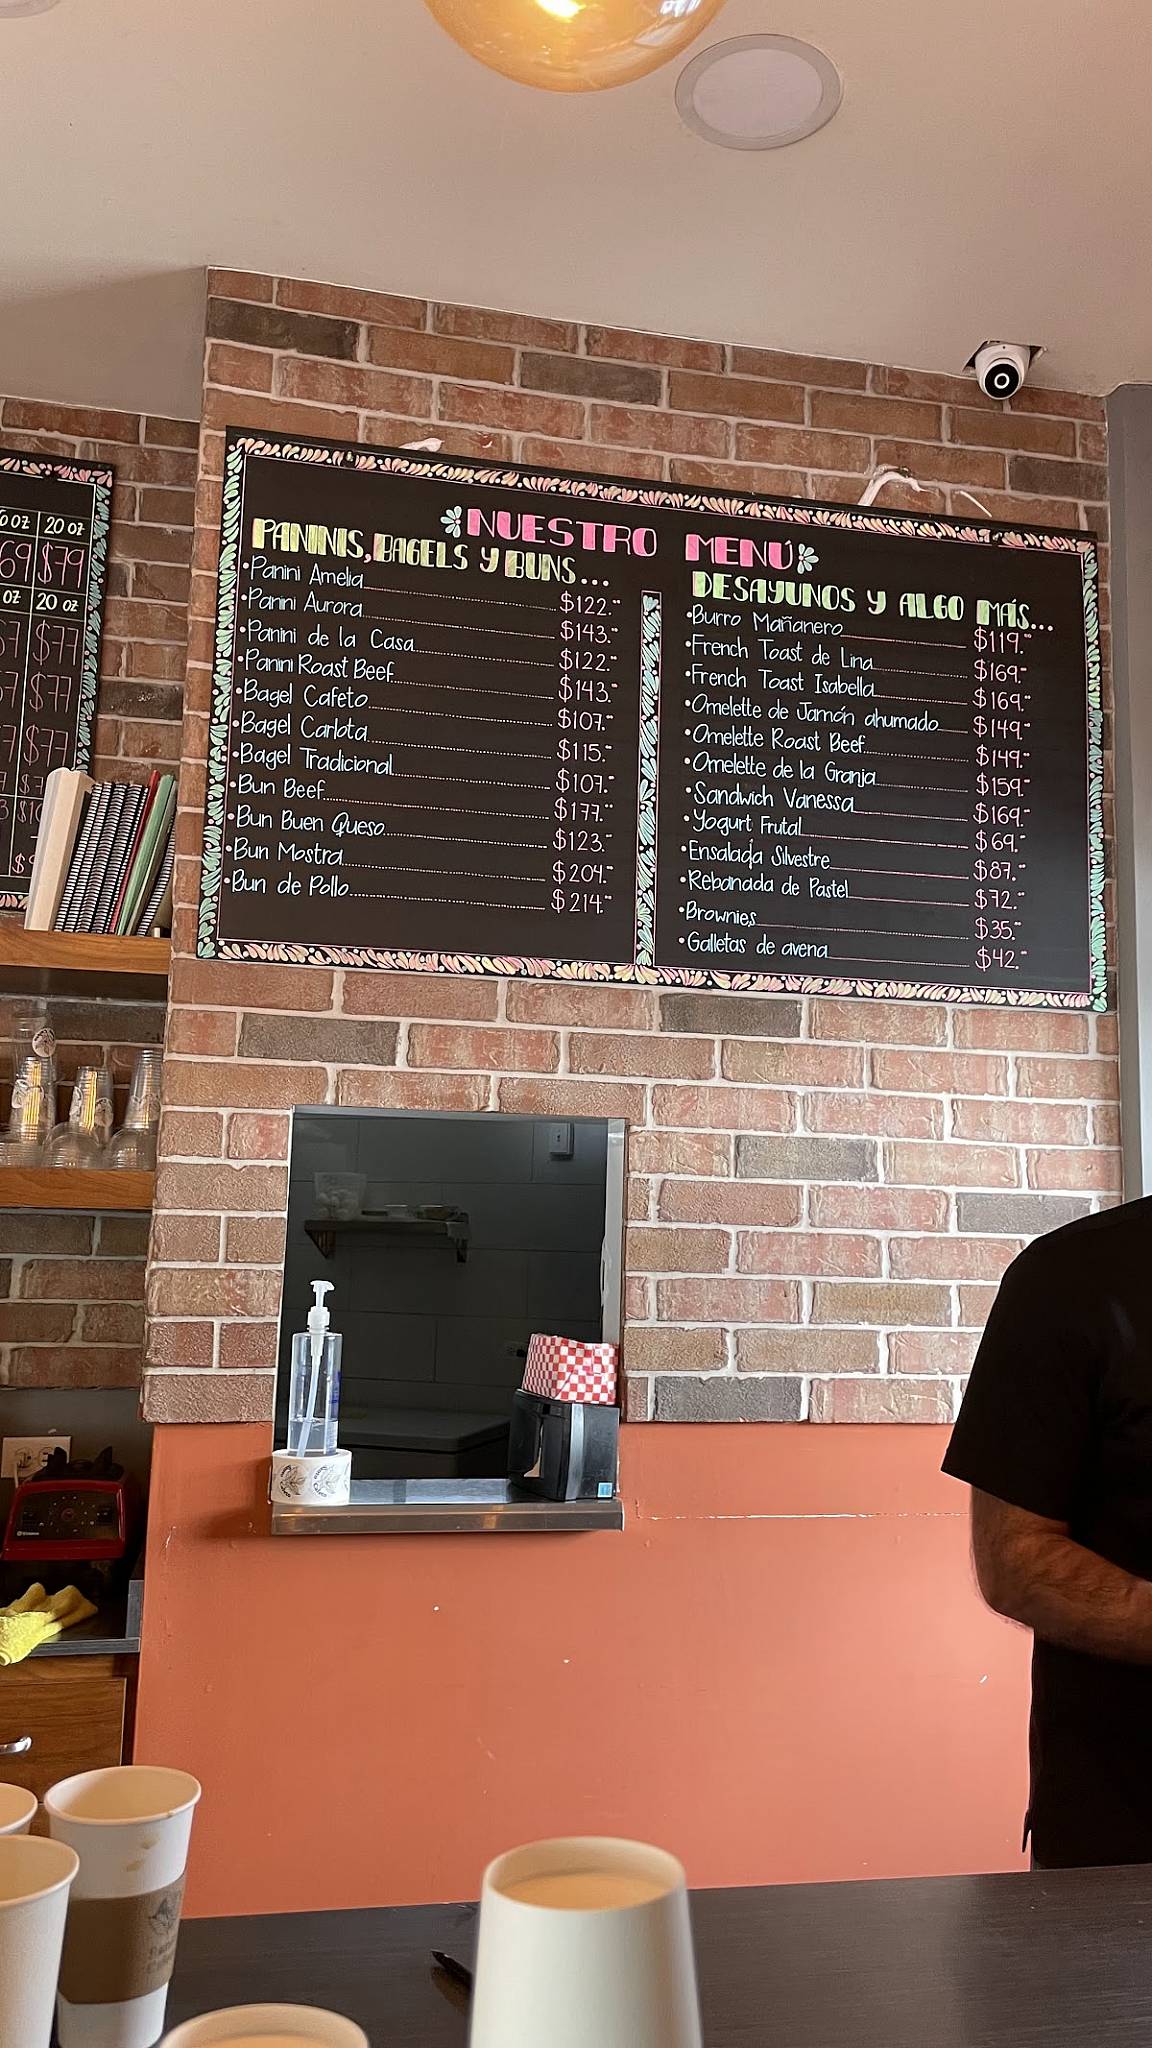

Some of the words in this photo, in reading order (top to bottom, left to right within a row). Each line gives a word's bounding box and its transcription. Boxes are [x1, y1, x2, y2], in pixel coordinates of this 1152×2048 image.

[44, 516, 65, 535] 20
[466, 508, 658, 557] NUESTRO
[685, 533, 794, 570] MENÚ
[0, 540, 32, 583] 69
[37, 541, 85, 589] $79
[374, 533, 468, 571] BAGELS
[250, 555, 301, 582] Panini
[309, 562, 364, 590] Amelia
[36, 592, 58, 611] 20
[248, 587, 297, 613] Panini
[303, 592, 363, 619] Aurora
[692, 571, 855, 612] DESAYUNOS
[899, 593, 964, 620] ALGO
[246, 618, 297, 644] Panini
[307, 626, 331, 647] de
[338, 623, 357, 648] la
[370, 629, 415, 653] Casa
[692, 604, 741, 627] Burro
[753, 611, 843, 637] Mañanero
[32, 619, 79, 666] $77
[691, 634, 749, 658] French
[757, 639, 803, 662] Toast
[811, 644, 830, 666] de
[840, 646, 874, 670] Lina
[244, 648, 294, 674] Panini
[297, 654, 349, 679] Roast
[353, 658, 394, 683] Beef
[691, 664, 747, 688] French
[757, 669, 804, 691] Toast
[814, 673, 875, 697] Isabella
[29, 671, 72, 713] $77
[243, 678, 293, 707] Bagel
[303, 684, 369, 708] Cafeto
[240, 710, 291, 738] Bagel
[300, 715, 368, 741] Carlota
[691, 694, 762, 718] Omelette
[768, 699, 789, 720] de
[796, 701, 855, 726] Jamón
[864, 708, 939, 732] ahumado
[23, 724, 69, 767] $77
[692, 723, 764, 747] Omelette
[771, 728, 821, 751] Roast
[829, 732, 866, 753] Beef
[240, 742, 291, 770] Bagel
[299, 747, 393, 776] Tradicional
[692, 751, 767, 777] Omelette
[772, 756, 794, 779] de
[799, 760, 815, 780] la
[824, 761, 876, 788] Granja
[19, 773, 44, 795] $7
[238, 773, 276, 795] Bun
[284, 778, 326, 800] Beef
[693, 781, 774, 807] Sandwich
[783, 787, 854, 812] Vanessa
[236, 804, 273, 828] Bun
[281, 810, 324, 832] Buen
[331, 812, 385, 837] Queso
[692, 808, 752, 836] Yogurt
[760, 815, 802, 836] Frutal
[233, 837, 269, 861] Bun
[278, 842, 343, 866] Mostra
[689, 839, 763, 870] Ensalada
[771, 845, 830, 869] Silvestre
[232, 869, 266, 893] Bun
[277, 872, 302, 895] de
[309, 875, 349, 897] Pollo
[688, 870, 774, 892] Rebanada
[781, 878, 800, 896] de
[809, 877, 848, 899] Pastel
[686, 900, 757, 927] Brownies
[687, 931, 746, 953] Galletas
[756, 934, 775, 955] de
[781, 941, 829, 958] avena
